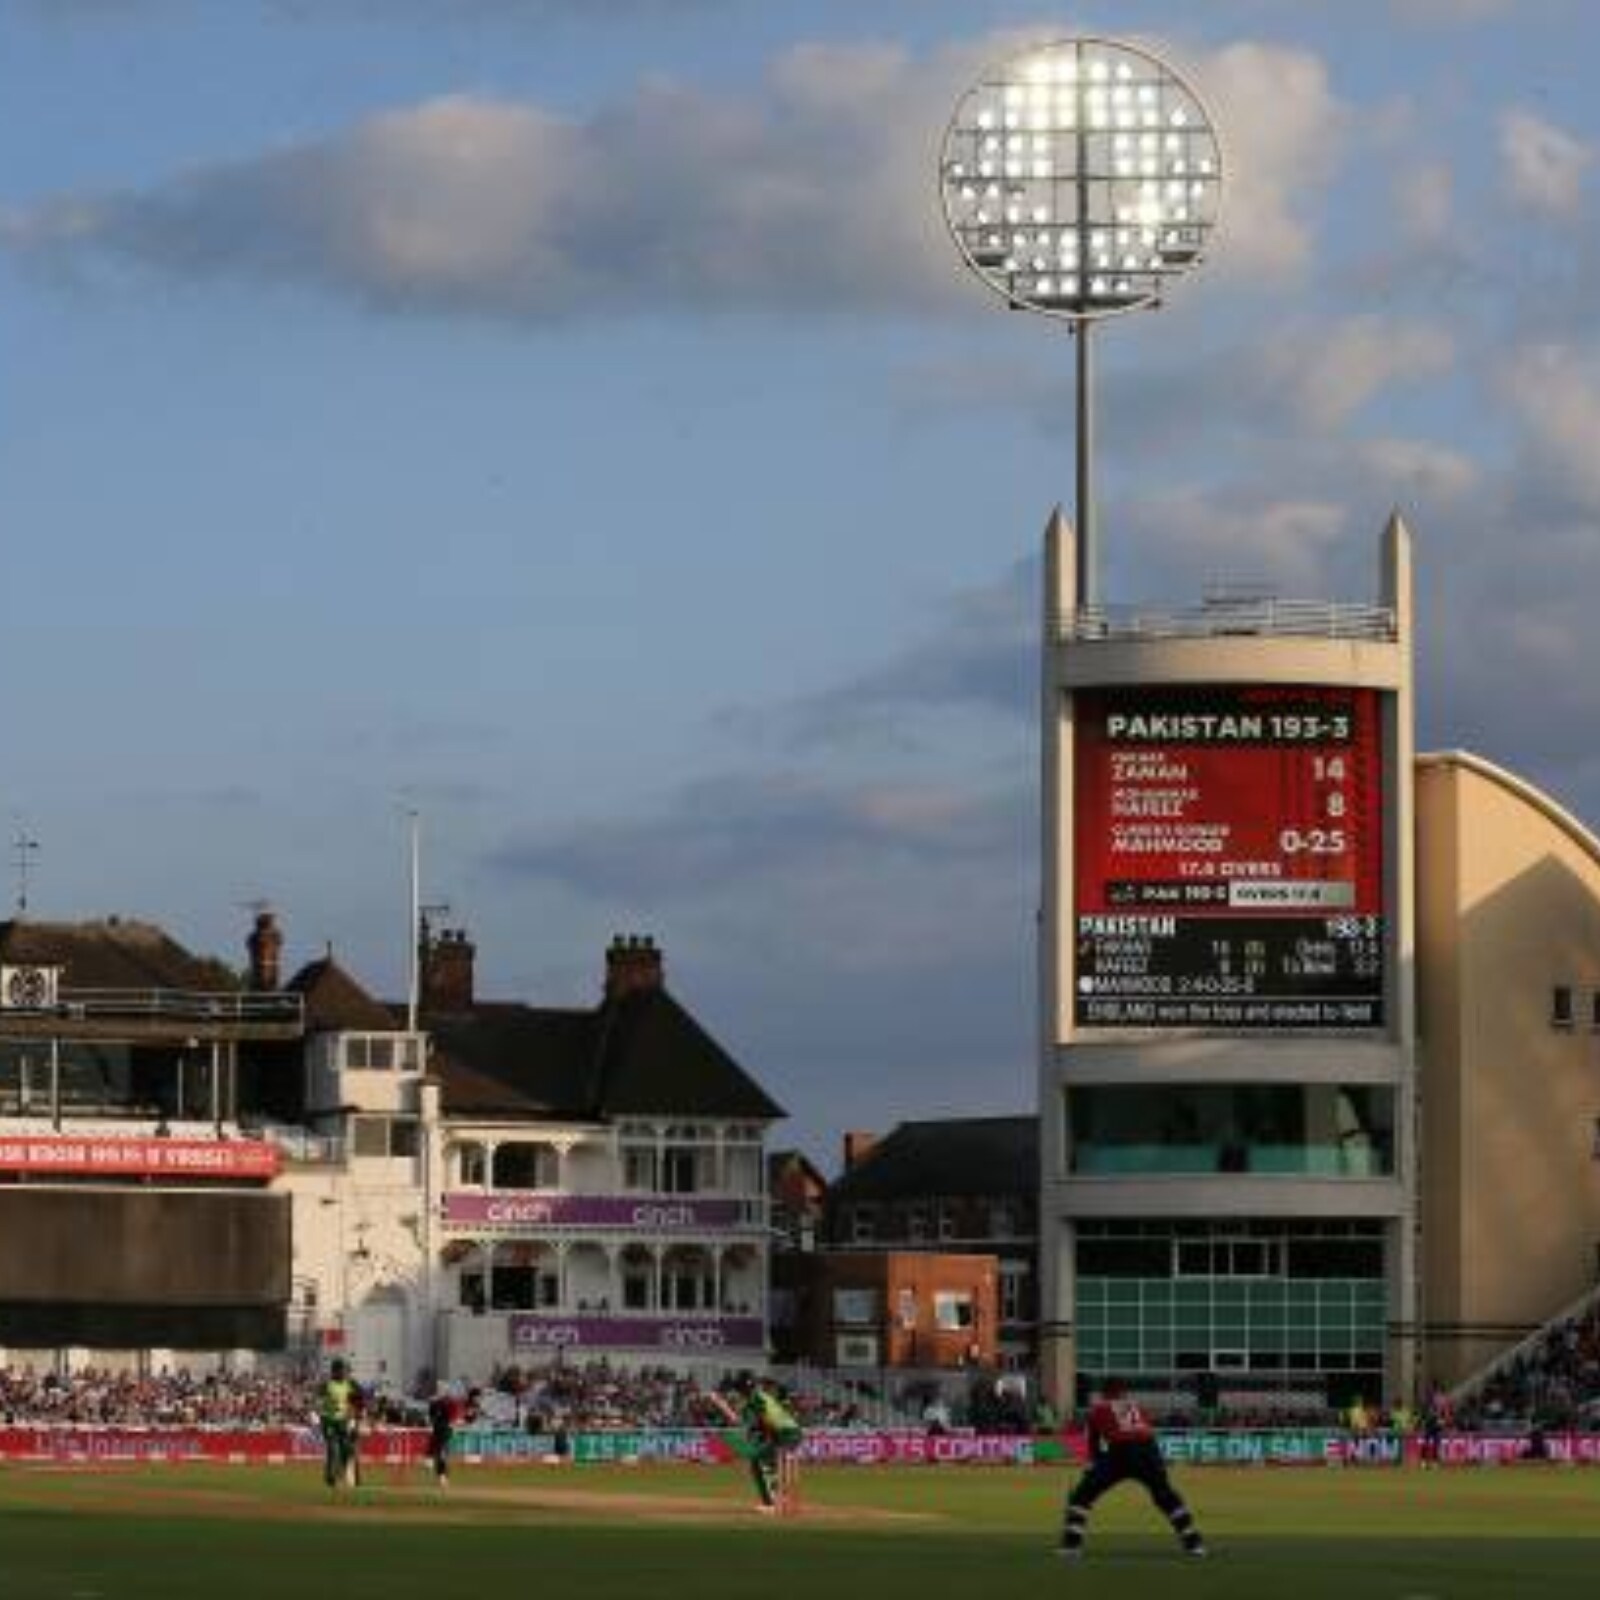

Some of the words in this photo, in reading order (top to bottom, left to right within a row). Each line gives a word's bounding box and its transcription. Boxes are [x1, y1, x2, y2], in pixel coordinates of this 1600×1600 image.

[1107, 716, 1262, 738] PAKISTAN
[1270, 716, 1349, 738] 193-3
[1312, 757, 1345, 781] 14
[1279, 830, 1346, 852] 0-25
[1079, 916, 1176, 937] PAKISTAN
[487, 1199, 551, 1221] cinch
[632, 1203, 694, 1225] cinch
[516, 1323, 579, 1344] cinch
[663, 1322, 725, 1345] cinch
[1345, 1436, 1399, 1459] NOW
